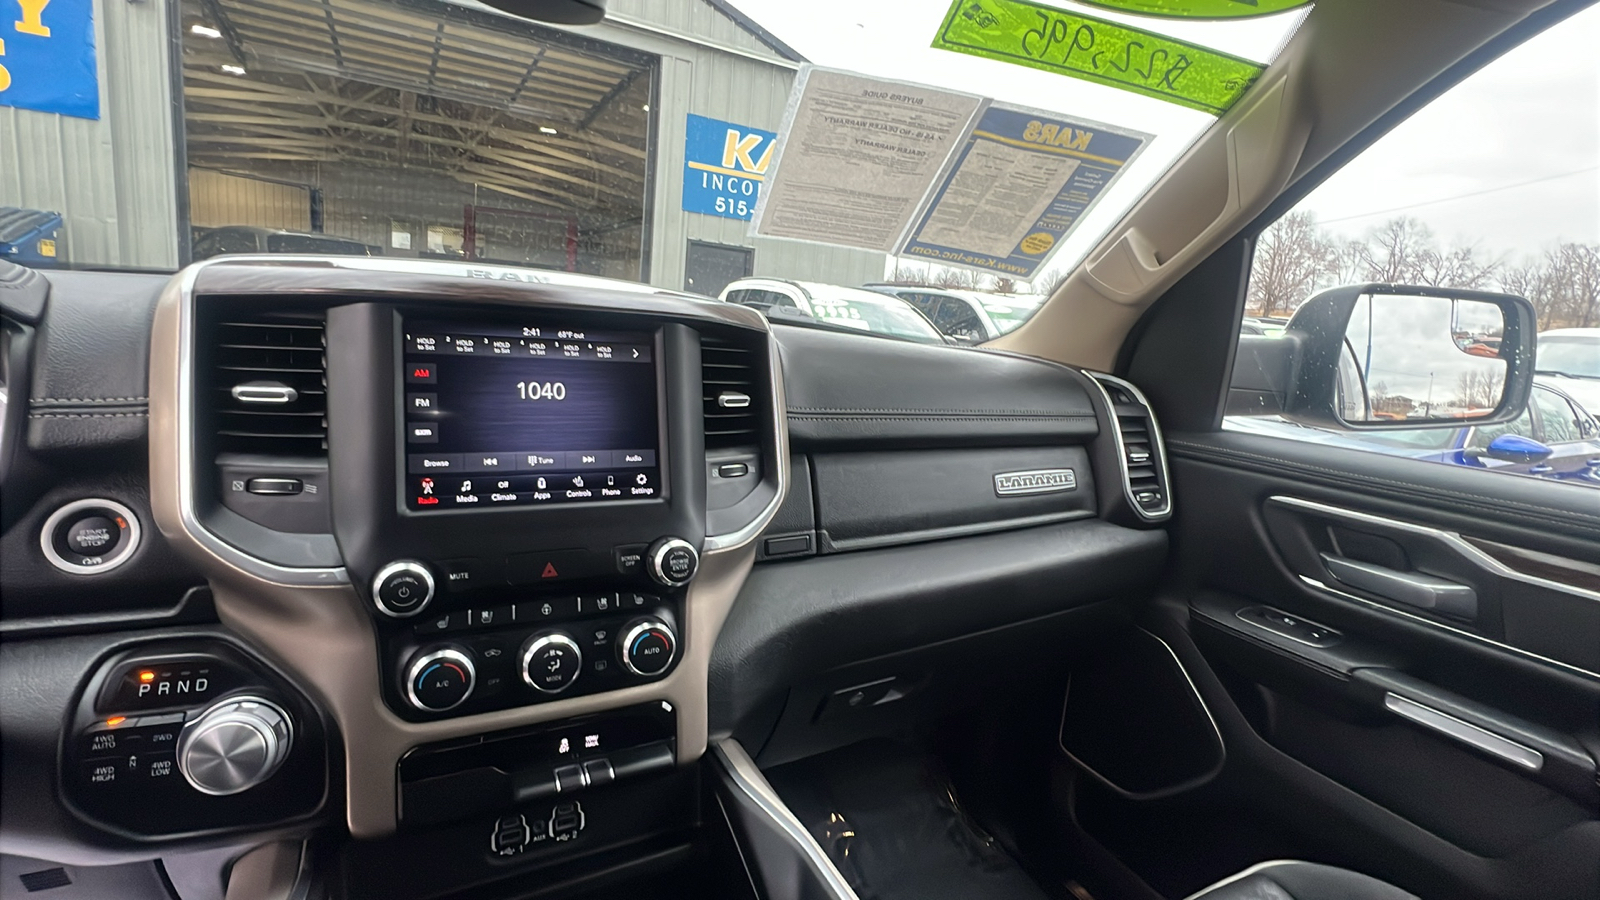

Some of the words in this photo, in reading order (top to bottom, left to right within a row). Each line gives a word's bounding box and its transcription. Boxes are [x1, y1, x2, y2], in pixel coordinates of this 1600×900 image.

[466, 269, 550, 284] RAM
[523, 327, 541, 337] 2:41
[414, 369, 430, 378] AM
[517, 382, 566, 400] 1040
[415, 398, 430, 407] FM
[424, 459, 449, 467] Browse
[998, 474, 1074, 489] LARAMIE
[566, 490, 592, 498] Controls
[602, 488, 621, 496] Phone
[631, 487, 654, 495] Settings
[456, 495, 478, 503] Media
[491, 493, 517, 502] Climate
[534, 492, 551, 500] Apps
[450, 572, 469, 580] MUTE
[644, 647, 660, 655] AUTO
[138, 683, 150, 697] P
[158, 682, 170, 695] R
[177, 680, 190, 693] N
[195, 678, 208, 691] D
[436, 680, 449, 688] A/C
[94, 735, 115, 743] 4WD
[92, 742, 116, 750] AUTO
[129, 759, 136, 767] N
[152, 761, 171, 769] 4WD
[94, 766, 115, 775] 4WD
[151, 768, 171, 776] LOW
[92, 774, 115, 782] HIGH
[533, 834, 546, 842] AUX
